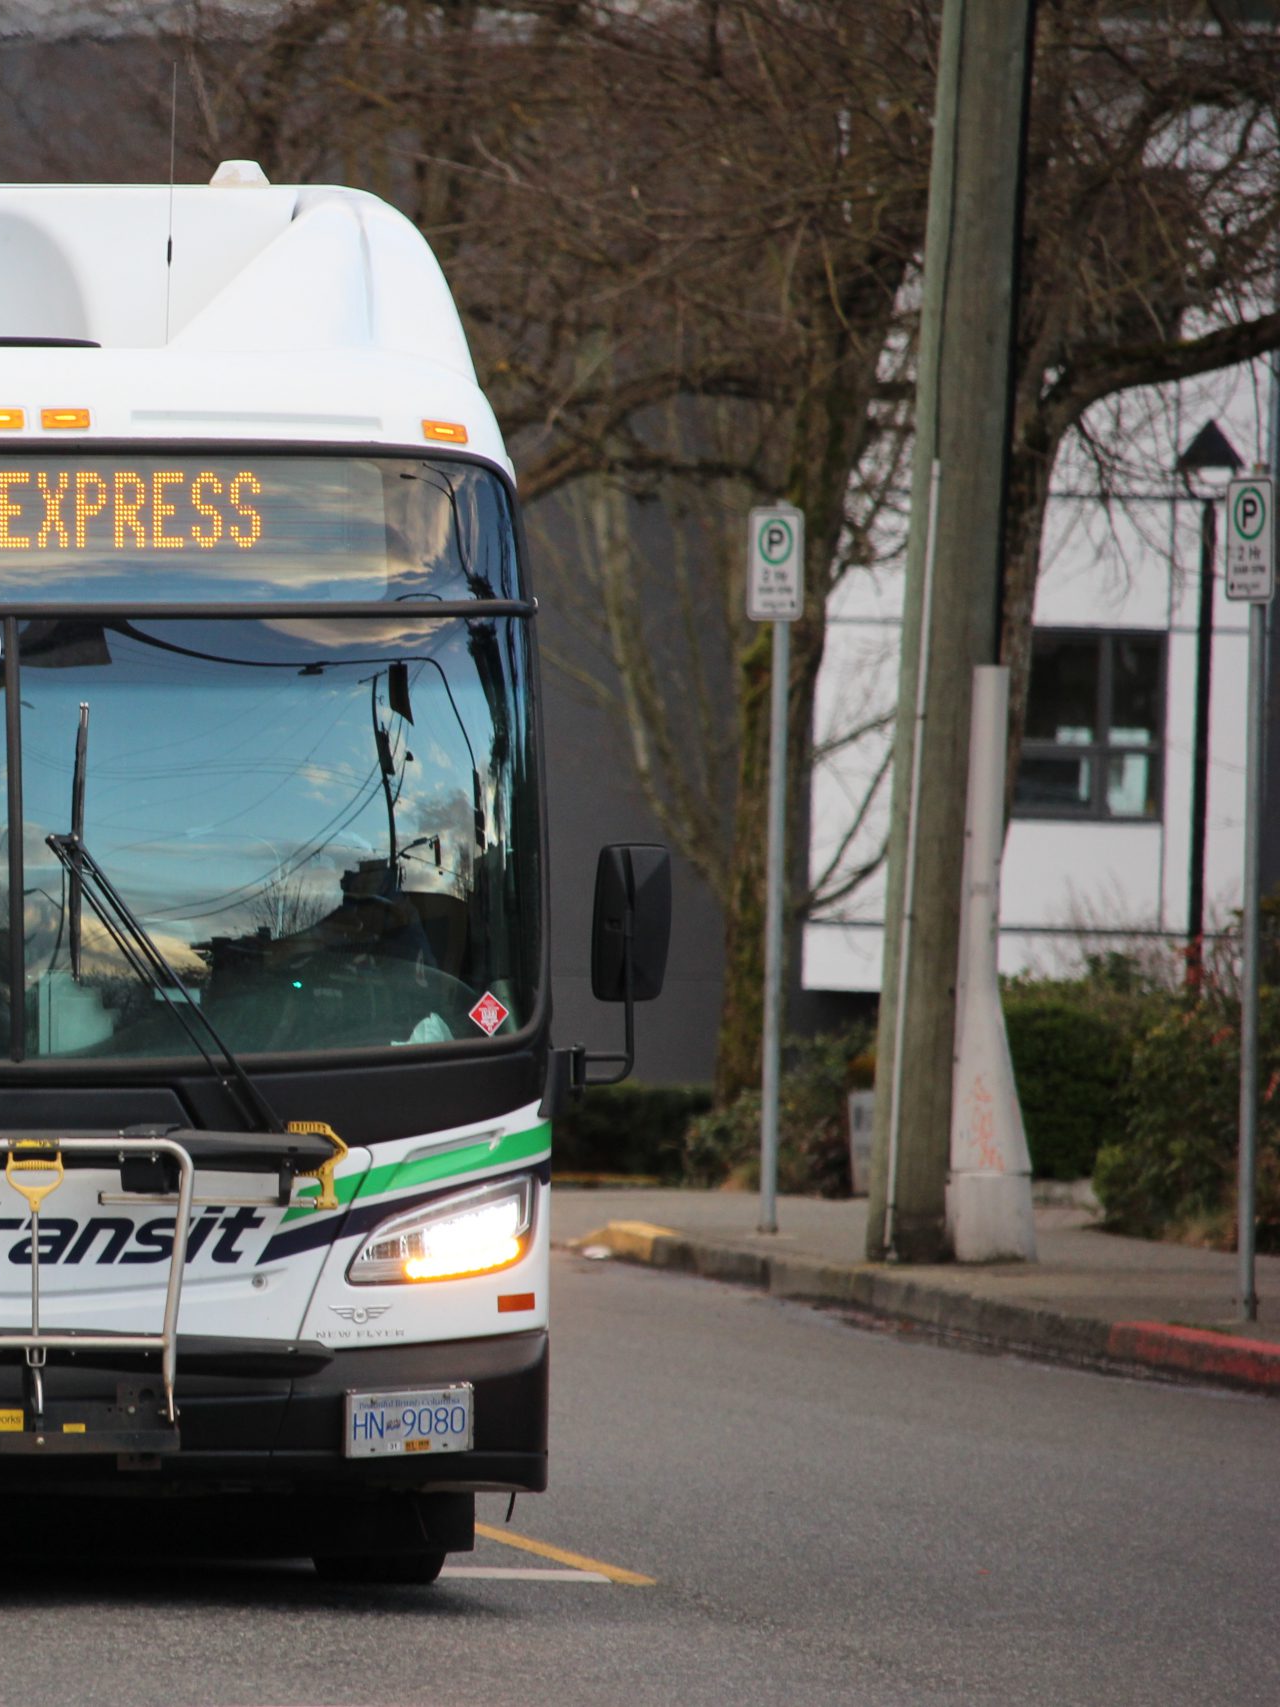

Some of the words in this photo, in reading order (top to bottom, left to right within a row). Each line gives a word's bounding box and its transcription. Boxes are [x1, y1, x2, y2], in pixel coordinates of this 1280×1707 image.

[1242, 498, 1258, 529] P
[767, 529, 784, 553] P
[316, 1330, 351, 1339] NEW
[357, 1329, 405, 1338] FLYER
[353, 1411, 385, 1441] HN
[402, 1406, 466, 1438] 9080
